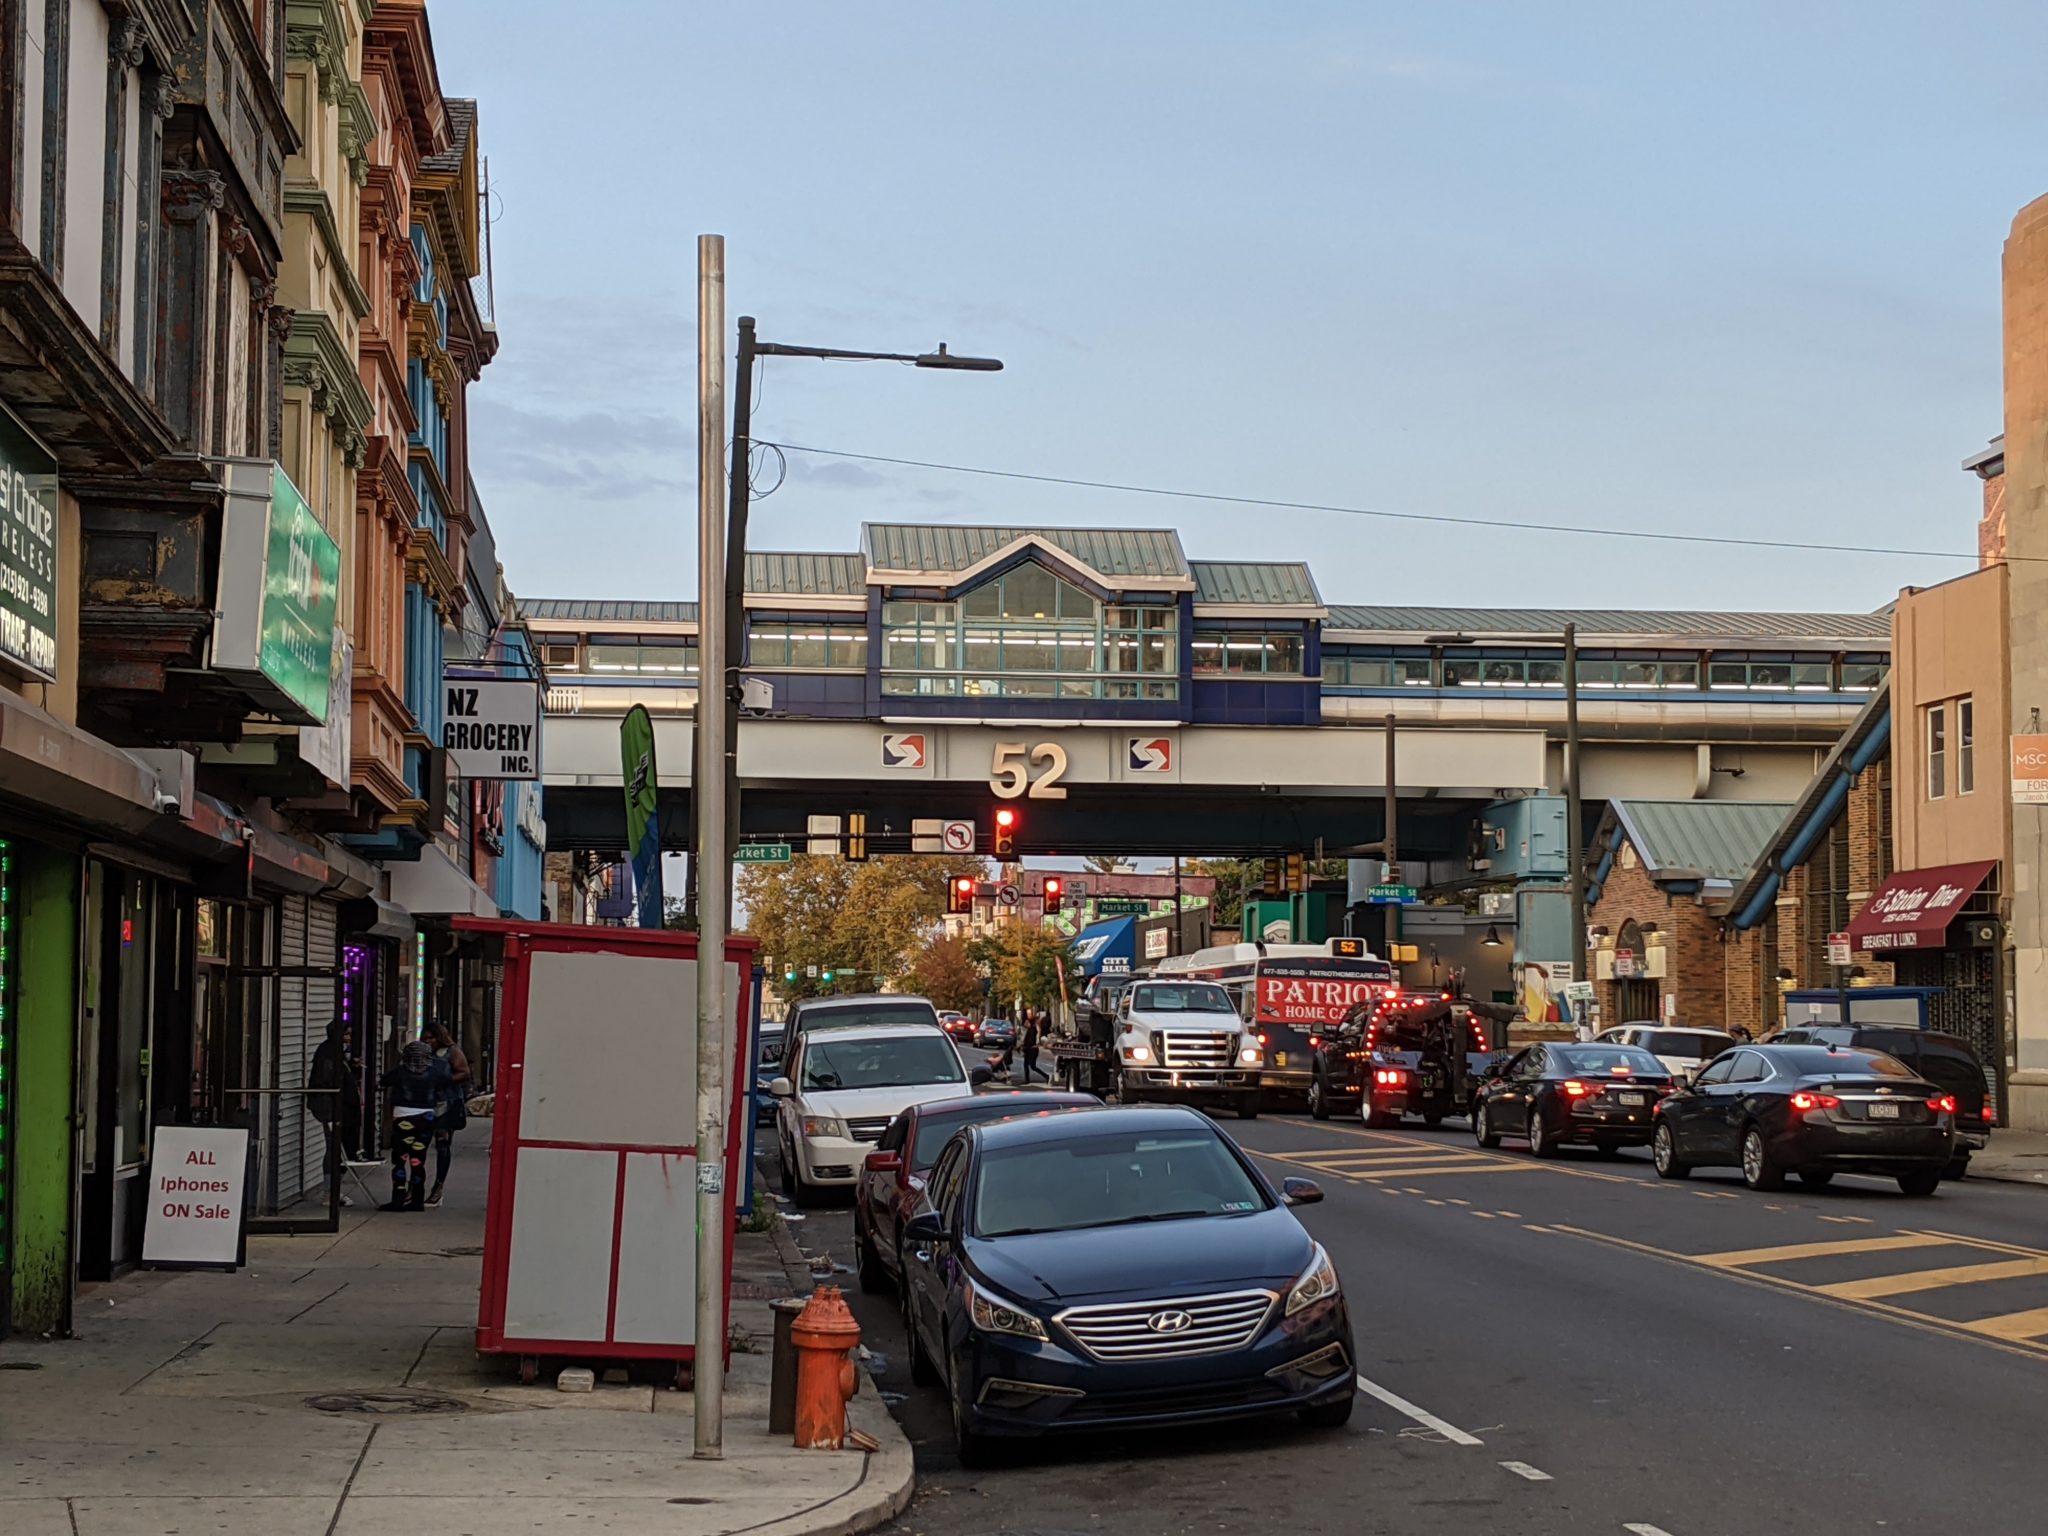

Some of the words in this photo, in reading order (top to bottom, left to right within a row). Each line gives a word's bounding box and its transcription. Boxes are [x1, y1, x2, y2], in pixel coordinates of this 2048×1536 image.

[14, 471, 52, 549] Choice
[1, 519, 52, 583] RELESS
[447, 688, 479, 717] NZ
[443, 722, 533, 752] GROCERY
[501, 755, 533, 773] INC.
[2016, 753, 2047, 765] MSC
[989, 742, 1067, 799] 52
[733, 847, 766, 860] arket
[770, 847, 783, 859] St
[1368, 887, 1400, 897] Market
[1407, 888, 1418, 897] St
[1924, 883, 1964, 909] Diner
[1101, 902, 1131, 912] Market
[1134, 902, 1144, 912] St
[1340, 941, 1356, 953] 52
[1862, 932, 1892, 949] BREAKFAST
[1899, 931, 1917, 947] LUNCH
[1101, 965, 1131, 973] BLUE
[1102, 957, 1130, 965] CITY
[1285, 1005, 1325, 1020] HOME
[1329, 1006, 1348, 1020] CA
[185, 1150, 217, 1166] ALL
[160, 1176, 230, 1194] Iphones
[162, 1203, 190, 1218] ON
[194, 1204, 231, 1220] Sale
